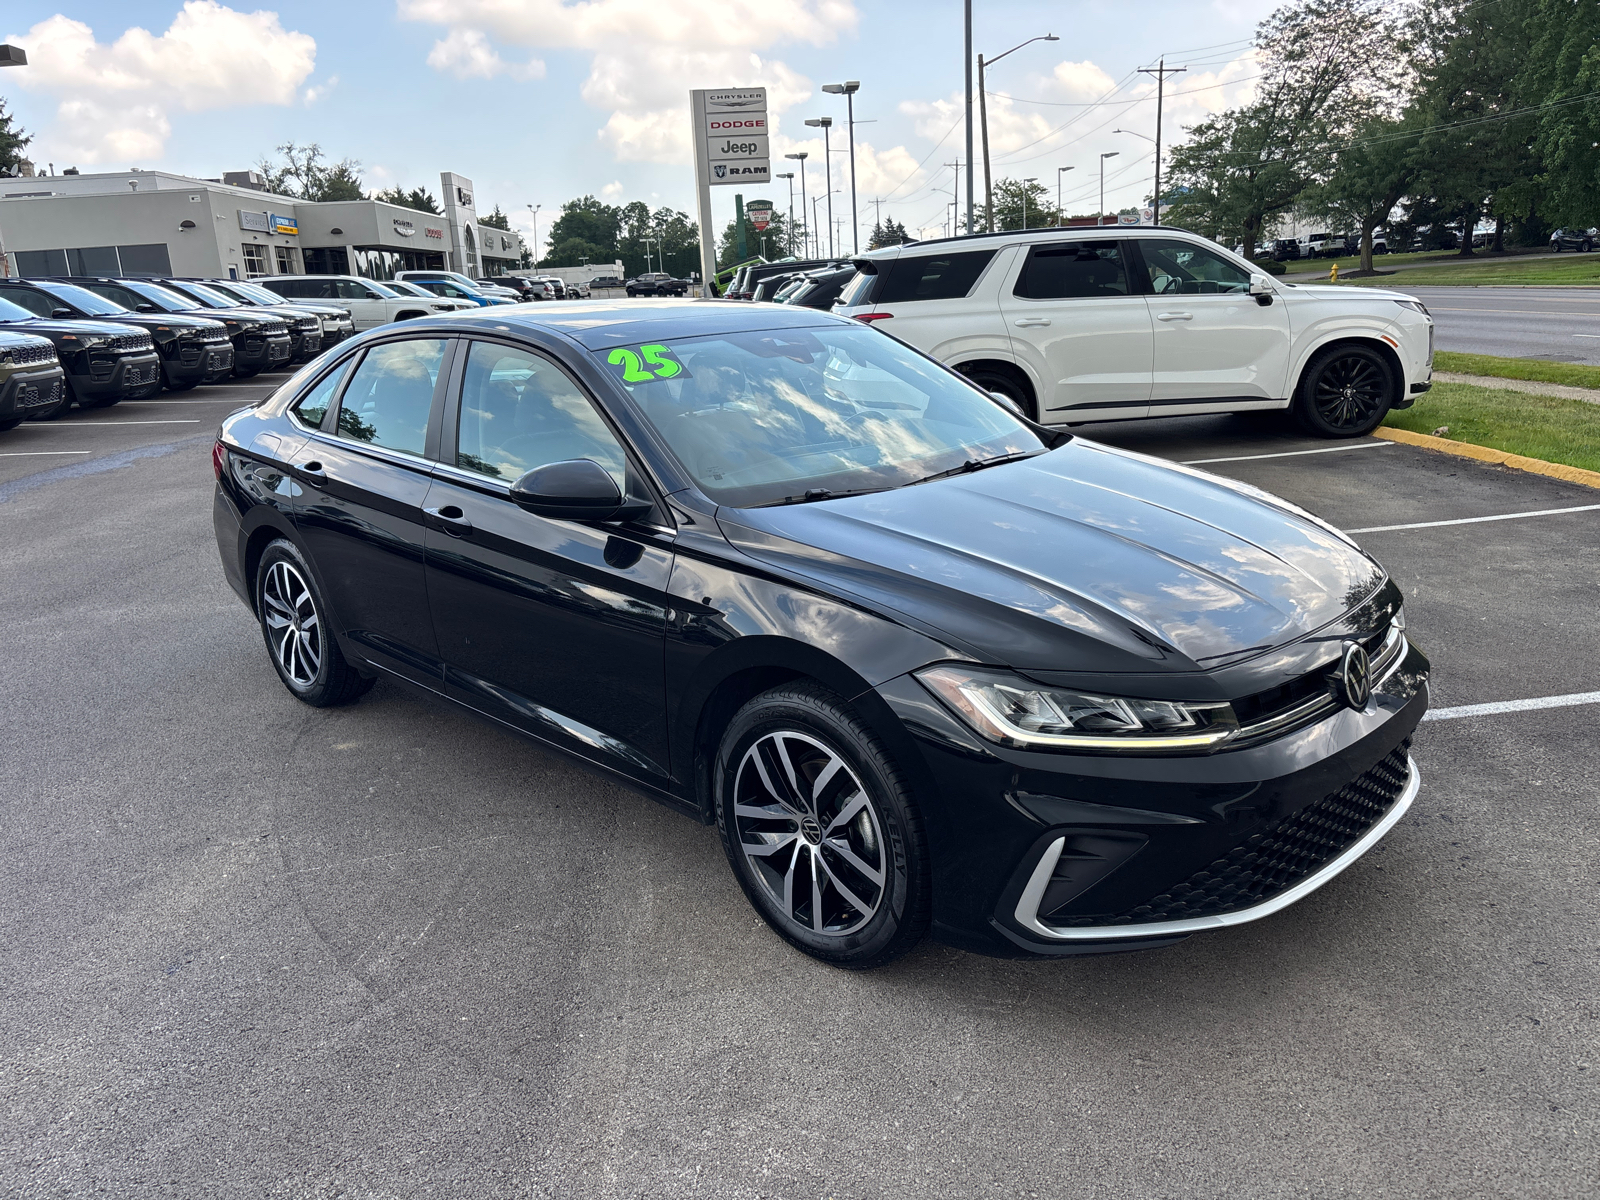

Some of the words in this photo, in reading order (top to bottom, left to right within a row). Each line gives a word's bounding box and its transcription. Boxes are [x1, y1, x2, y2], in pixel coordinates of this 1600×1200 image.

[710, 119, 765, 129] DODGE
[721, 140, 758, 155] Jeep
[729, 166, 767, 175] RAM
[244, 215, 267, 227] Service
[607, 344, 683, 383] 25
[882, 806, 906, 878] KELLY
